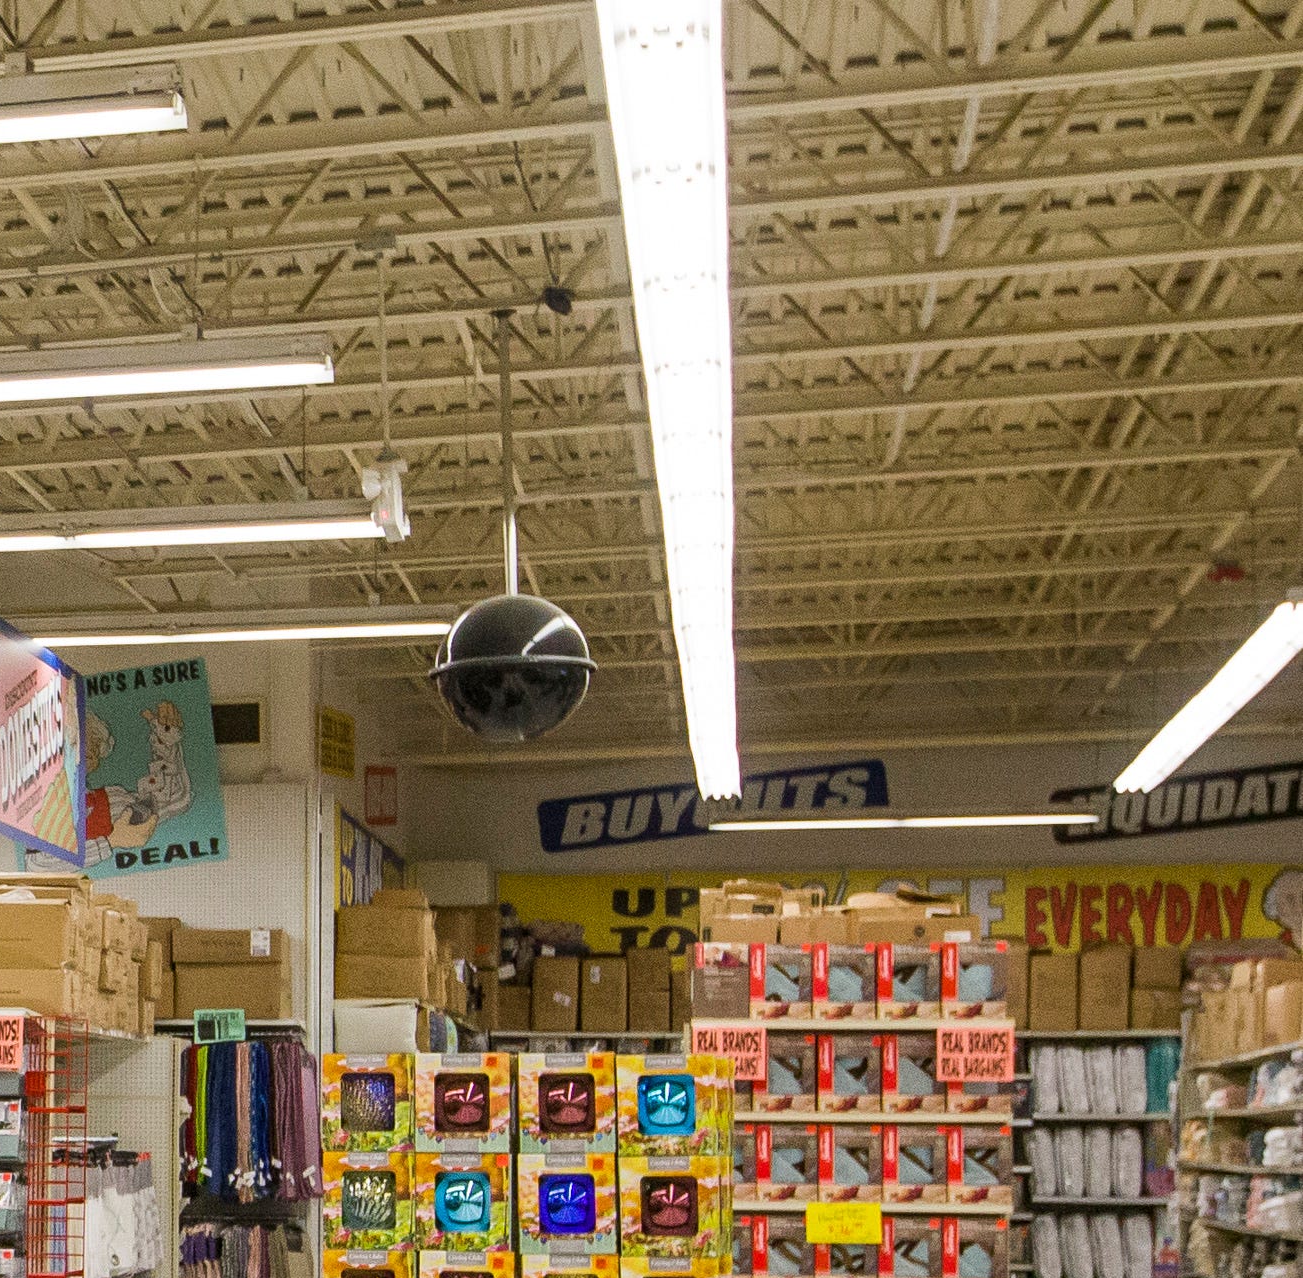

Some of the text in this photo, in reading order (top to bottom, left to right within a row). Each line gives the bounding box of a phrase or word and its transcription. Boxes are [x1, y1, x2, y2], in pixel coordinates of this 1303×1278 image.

[86, 659, 200, 697] NG'S A SURE
[114, 837, 220, 870] DEAL!
[611, 886, 700, 918] UP
[1024, 878, 1251, 948] EVERYDAY
[696, 1030, 763, 1053] REAL BRANDS!
[942, 1031, 1008, 1053] REAL BRANDS!
[942, 1056, 1006, 1078] REAL BARGAINS!
